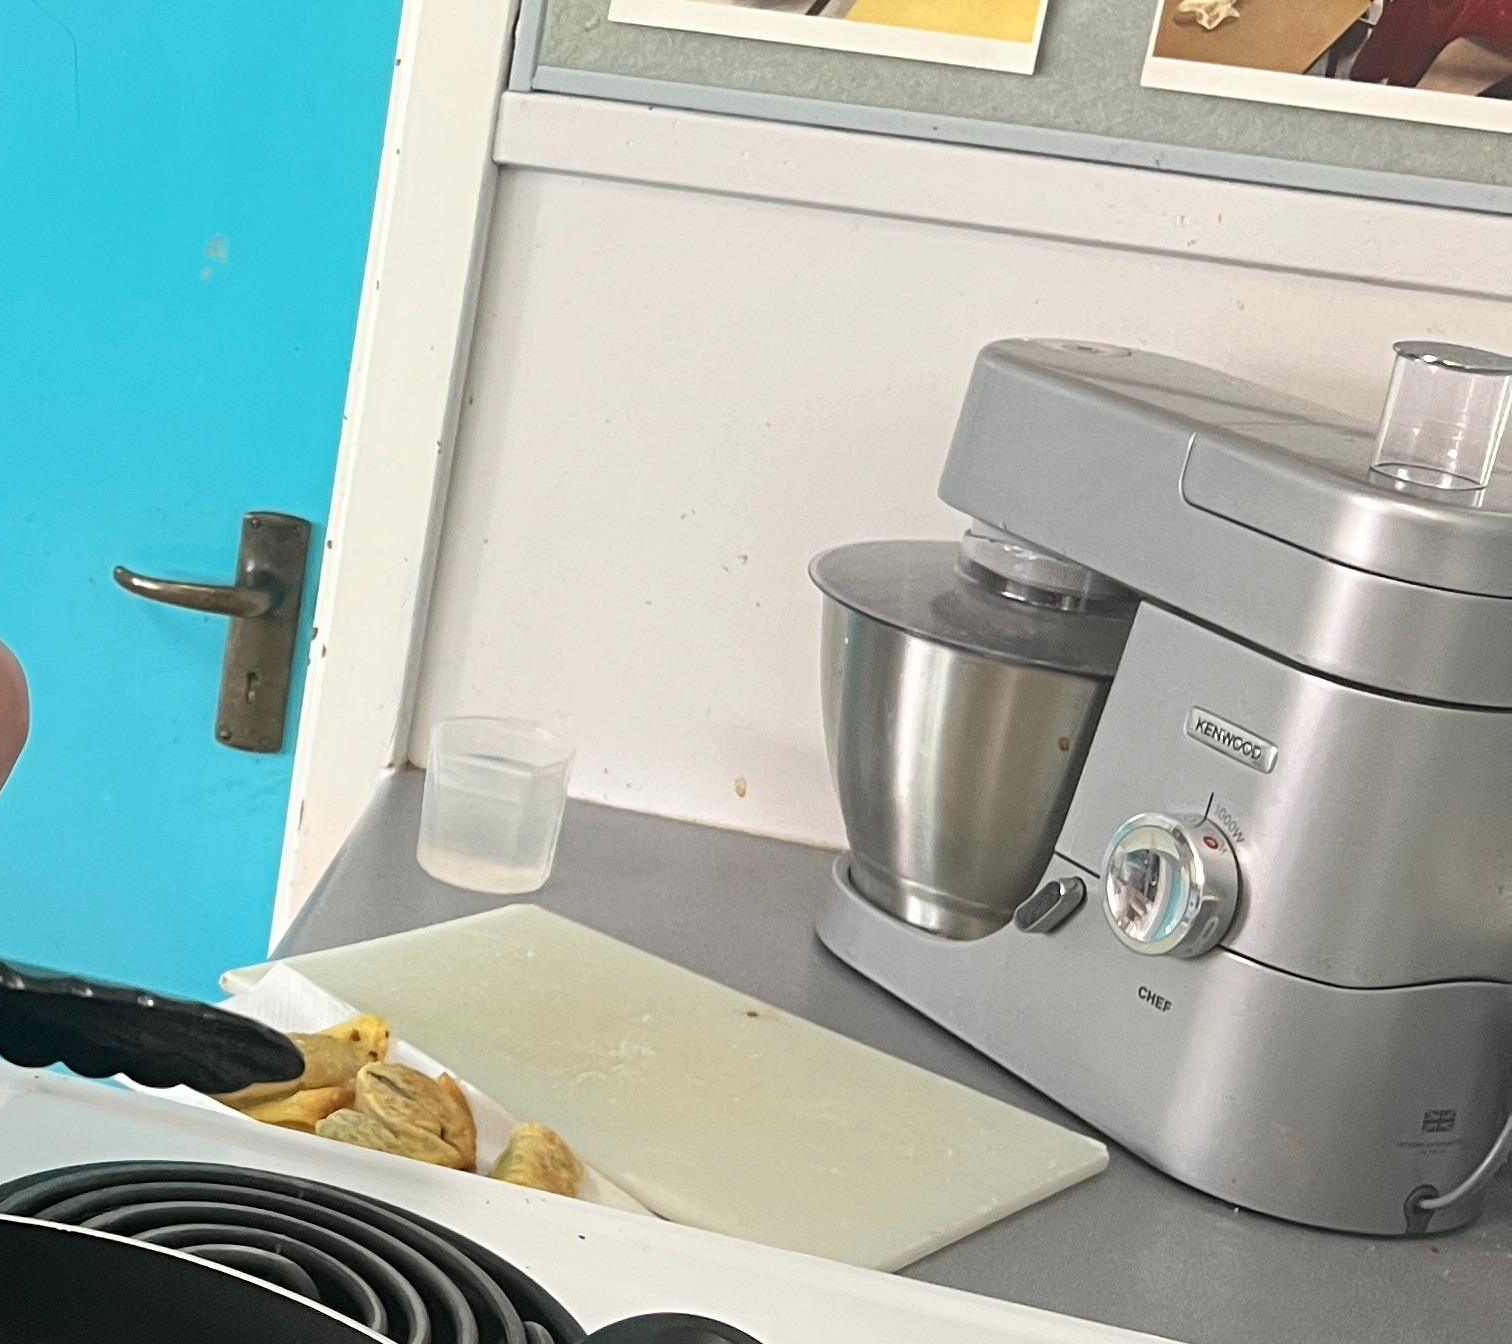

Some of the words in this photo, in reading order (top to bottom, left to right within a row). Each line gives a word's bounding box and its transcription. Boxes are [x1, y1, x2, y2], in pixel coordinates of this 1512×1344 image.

[1194, 716, 1262, 760] KENWOOD
[1213, 803, 1246, 844] 1000W
[1137, 985, 1173, 1013] CHEF
